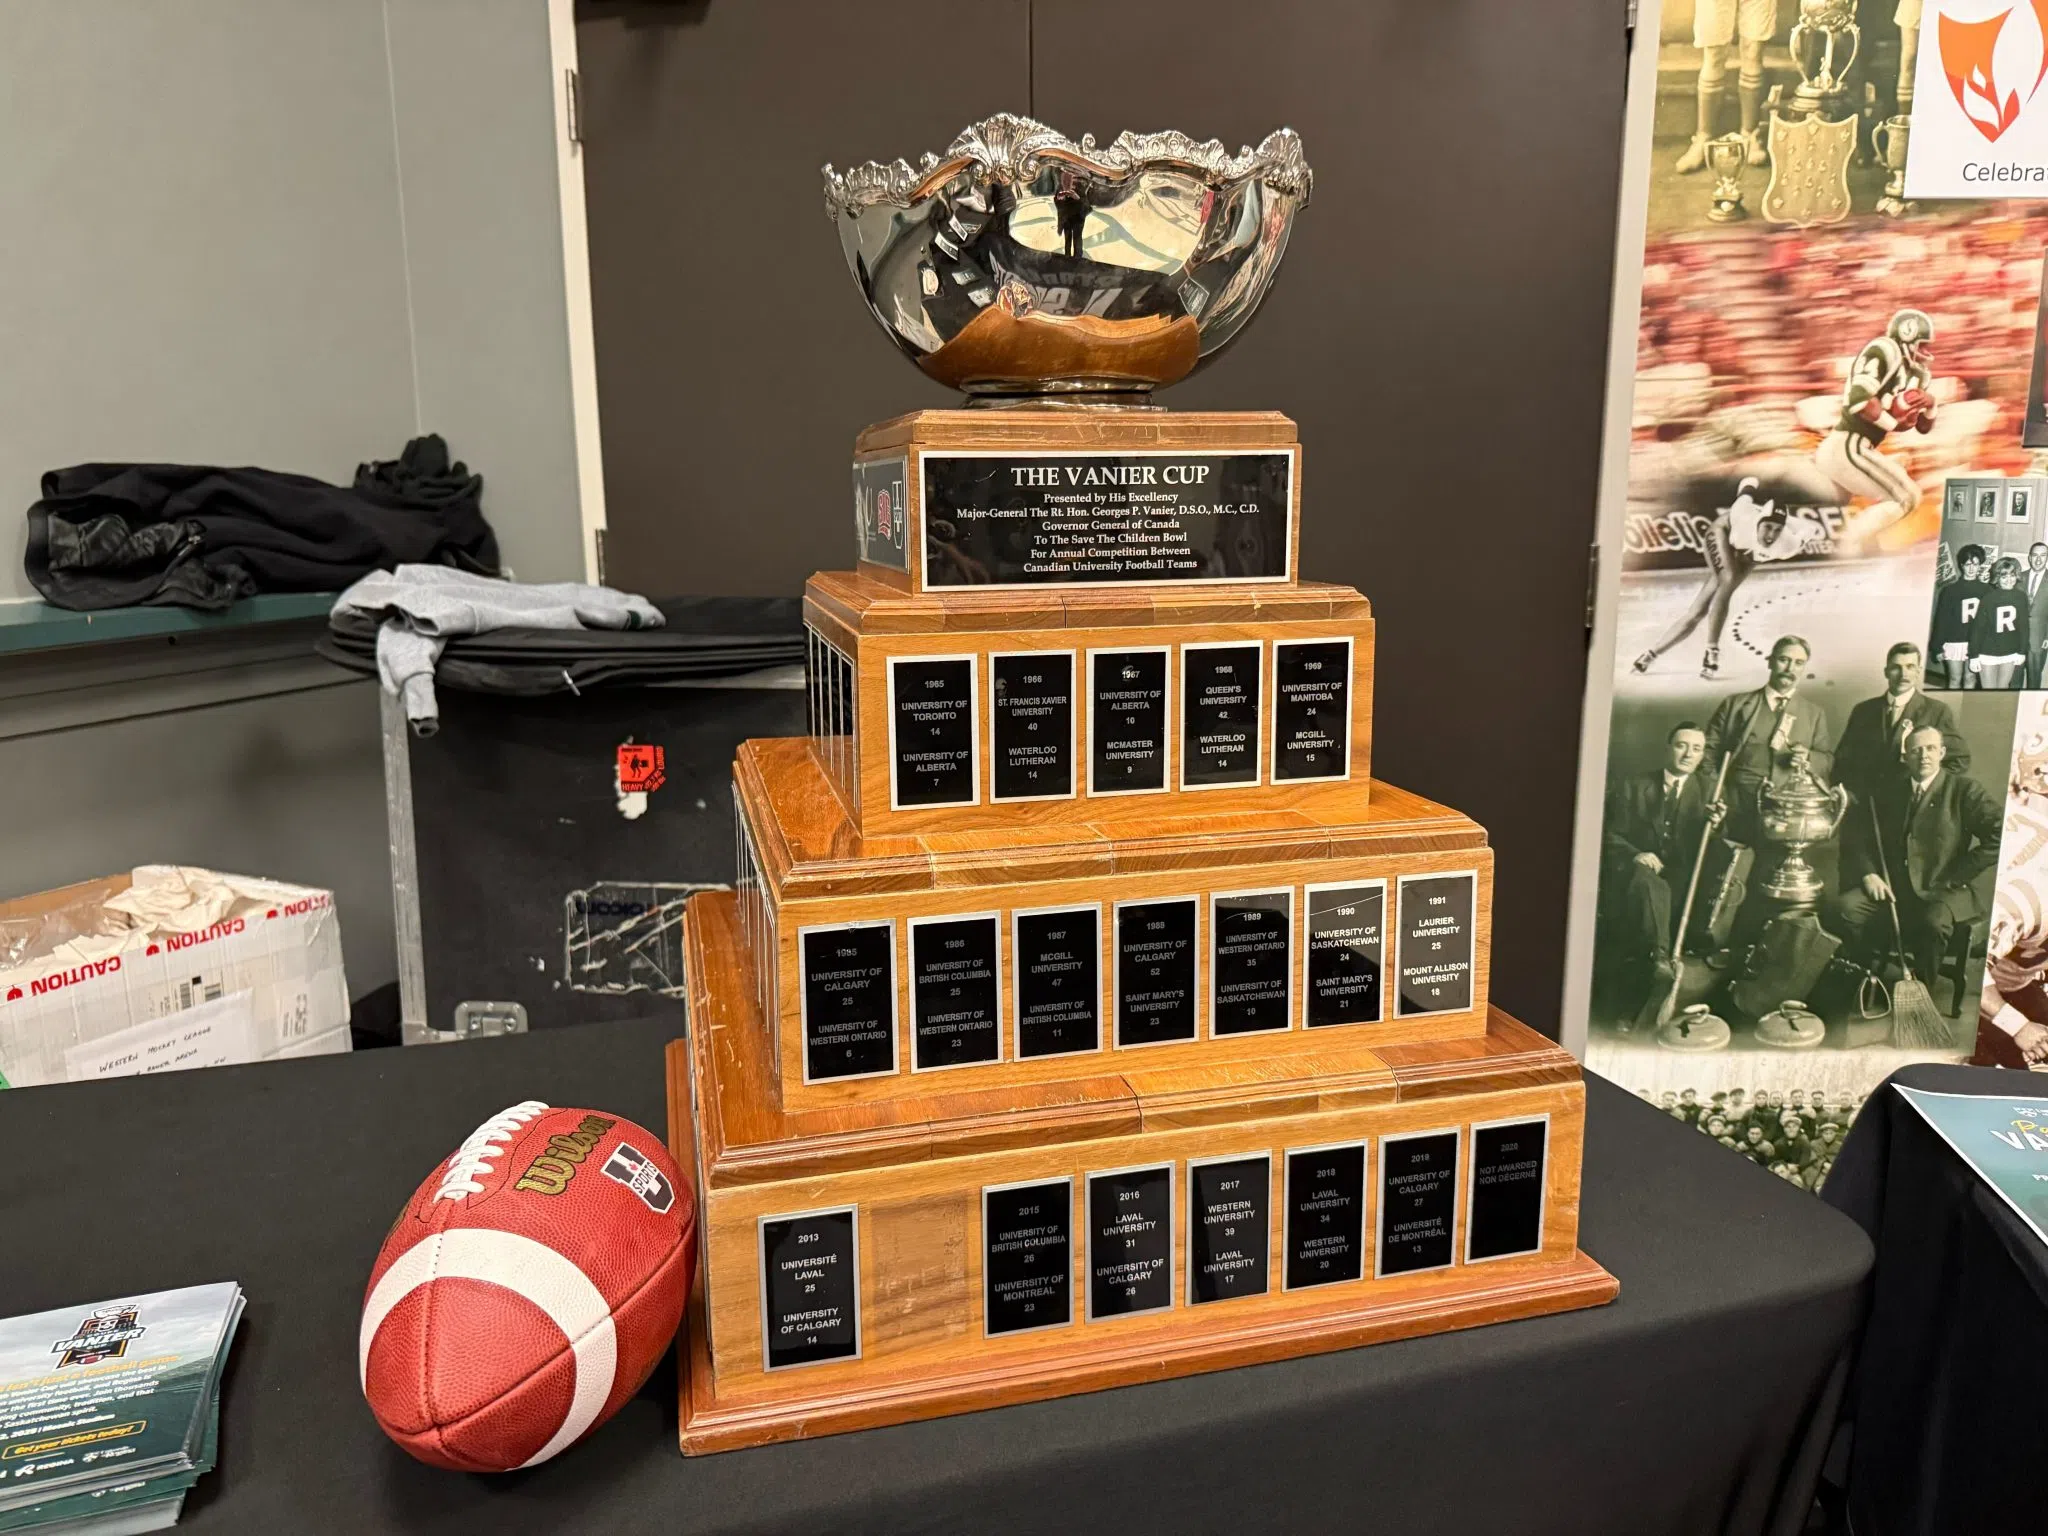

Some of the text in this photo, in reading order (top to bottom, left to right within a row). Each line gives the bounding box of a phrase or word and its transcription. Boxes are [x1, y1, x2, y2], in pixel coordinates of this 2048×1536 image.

[1962, 162, 2048, 182] Celebra
[1011, 465, 1210, 486] THE VANIER CUP
[1043, 492, 1179, 505] Presented by His Excellency
[957, 504, 1260, 520] Major-General The Rt. Hon. Georges P. Vanier, D.S.O., M.C., C.D.
[1042, 519, 1180, 531] Governor General of Canada
[1034, 532, 1188, 545] To The Save The Children Bowl
[1030, 546, 1191, 559] For Annual Competition Between
[1023, 558, 1198, 573] Canadian University Football Teams
[1996, 605, 2017, 633] R
[1214, 665, 1233, 674] 1968
[1303, 662, 1323, 671] 1969
[924, 680, 945, 689] 1965
[1022, 675, 1043, 684] 1966
[1205, 685, 1241, 694] QUEEN'S
[1281, 681, 1342, 692] UNIVERSITY OF
[1099, 690, 1161, 700] UNIVERSITY OF
[1199, 695, 1247, 705] UNIVERSITY
[1290, 692, 1333, 702] MANITOBA
[901, 699, 967, 711] UNIVERSITY OF
[998, 695, 1067, 707] ST. FRANCIS XAVIER
[1110, 701, 1150, 710] ALBERTA
[912, 711, 956, 721] TORONTO
[1011, 706, 1053, 716] UNIVERSITY
[1306, 707, 1316, 715] 24
[1125, 716, 1135, 724] 10
[930, 727, 940, 735] 14
[1027, 722, 1038, 731] 40
[1199, 733, 1246, 743] WATERLOO
[1295, 730, 1326, 739] MCGILL
[1106, 739, 1153, 749] MCMASTER
[1201, 744, 1244, 754] LUTHERAN
[1286, 739, 1334, 750] UNIVERSITY
[902, 750, 968, 762] UNIVERSITY OF
[1008, 745, 1057, 756] WATERLOO
[1105, 750, 1154, 760] UNIVERSITY
[1009, 756, 1056, 766] LUTHERAN
[1217, 759, 1227, 767] 14
[1306, 753, 1315, 762] 15
[915, 762, 957, 772] ALBERTA
[1127, 765, 1132, 773] 9
[1027, 770, 1037, 779] 14
[933, 778, 939, 786] 7
[1428, 896, 1446, 905] 1991
[1336, 907, 1355, 917] 1990
[1418, 916, 1454, 927] LAURIER
[166, 918, 246, 952] CAUTION
[1314, 926, 1376, 939] UNIVERSITY OF
[1412, 925, 1460, 938] UNIVERSITY
[1311, 936, 1379, 950] SASKATCHEWAN
[1431, 941, 1441, 950] 25
[1339, 953, 1350, 962] 24
[1403, 961, 1469, 976] MOUNT ALLISON
[30, 955, 121, 997] CAUTION
[1315, 974, 1373, 987] SAINT MARY'S
[1412, 972, 1459, 985] UNIVERSITY
[1320, 984, 1368, 996] UNIVERSITY
[1430, 988, 1440, 996] 18
[1339, 999, 1349, 1008] 21
[1990, 1130, 2048, 1151] VA
[514, 1114, 617, 1195] Wilson
[632, 1162, 658, 1194] SPORTS
[1220, 1180, 1240, 1190] 2017
[1119, 1190, 1140, 1201] 2016
[1207, 1200, 1251, 1213] WESTERN
[1115, 1212, 1144, 1224] LAVAL
[1204, 1209, 1255, 1224] UNIVERSITY
[1103, 1220, 1156, 1236] UNIVERSITY
[1224, 1227, 1235, 1236] 39
[798, 1233, 819, 1243] 2013
[1125, 1238, 1135, 1248] 31
[1215, 1250, 1243, 1261] LAVAL
[781, 1253, 837, 1270] UNIVERSITÉ
[1096, 1258, 1164, 1276] UNIVERSITY OF
[1203, 1257, 1255, 1273] UNIVERSITY
[794, 1269, 825, 1280] LAVAL
[1108, 1270, 1152, 1285] CALGARY
[1224, 1275, 1235, 1284] 17
[804, 1284, 816, 1293] 25
[1125, 1286, 1136, 1295] 26
[783, 1307, 838, 1322] UNIVERSITY
[780, 1317, 841, 1334] OF CALGARY
[55, 1328, 143, 1352] VANIER
[806, 1335, 817, 1344] 14
